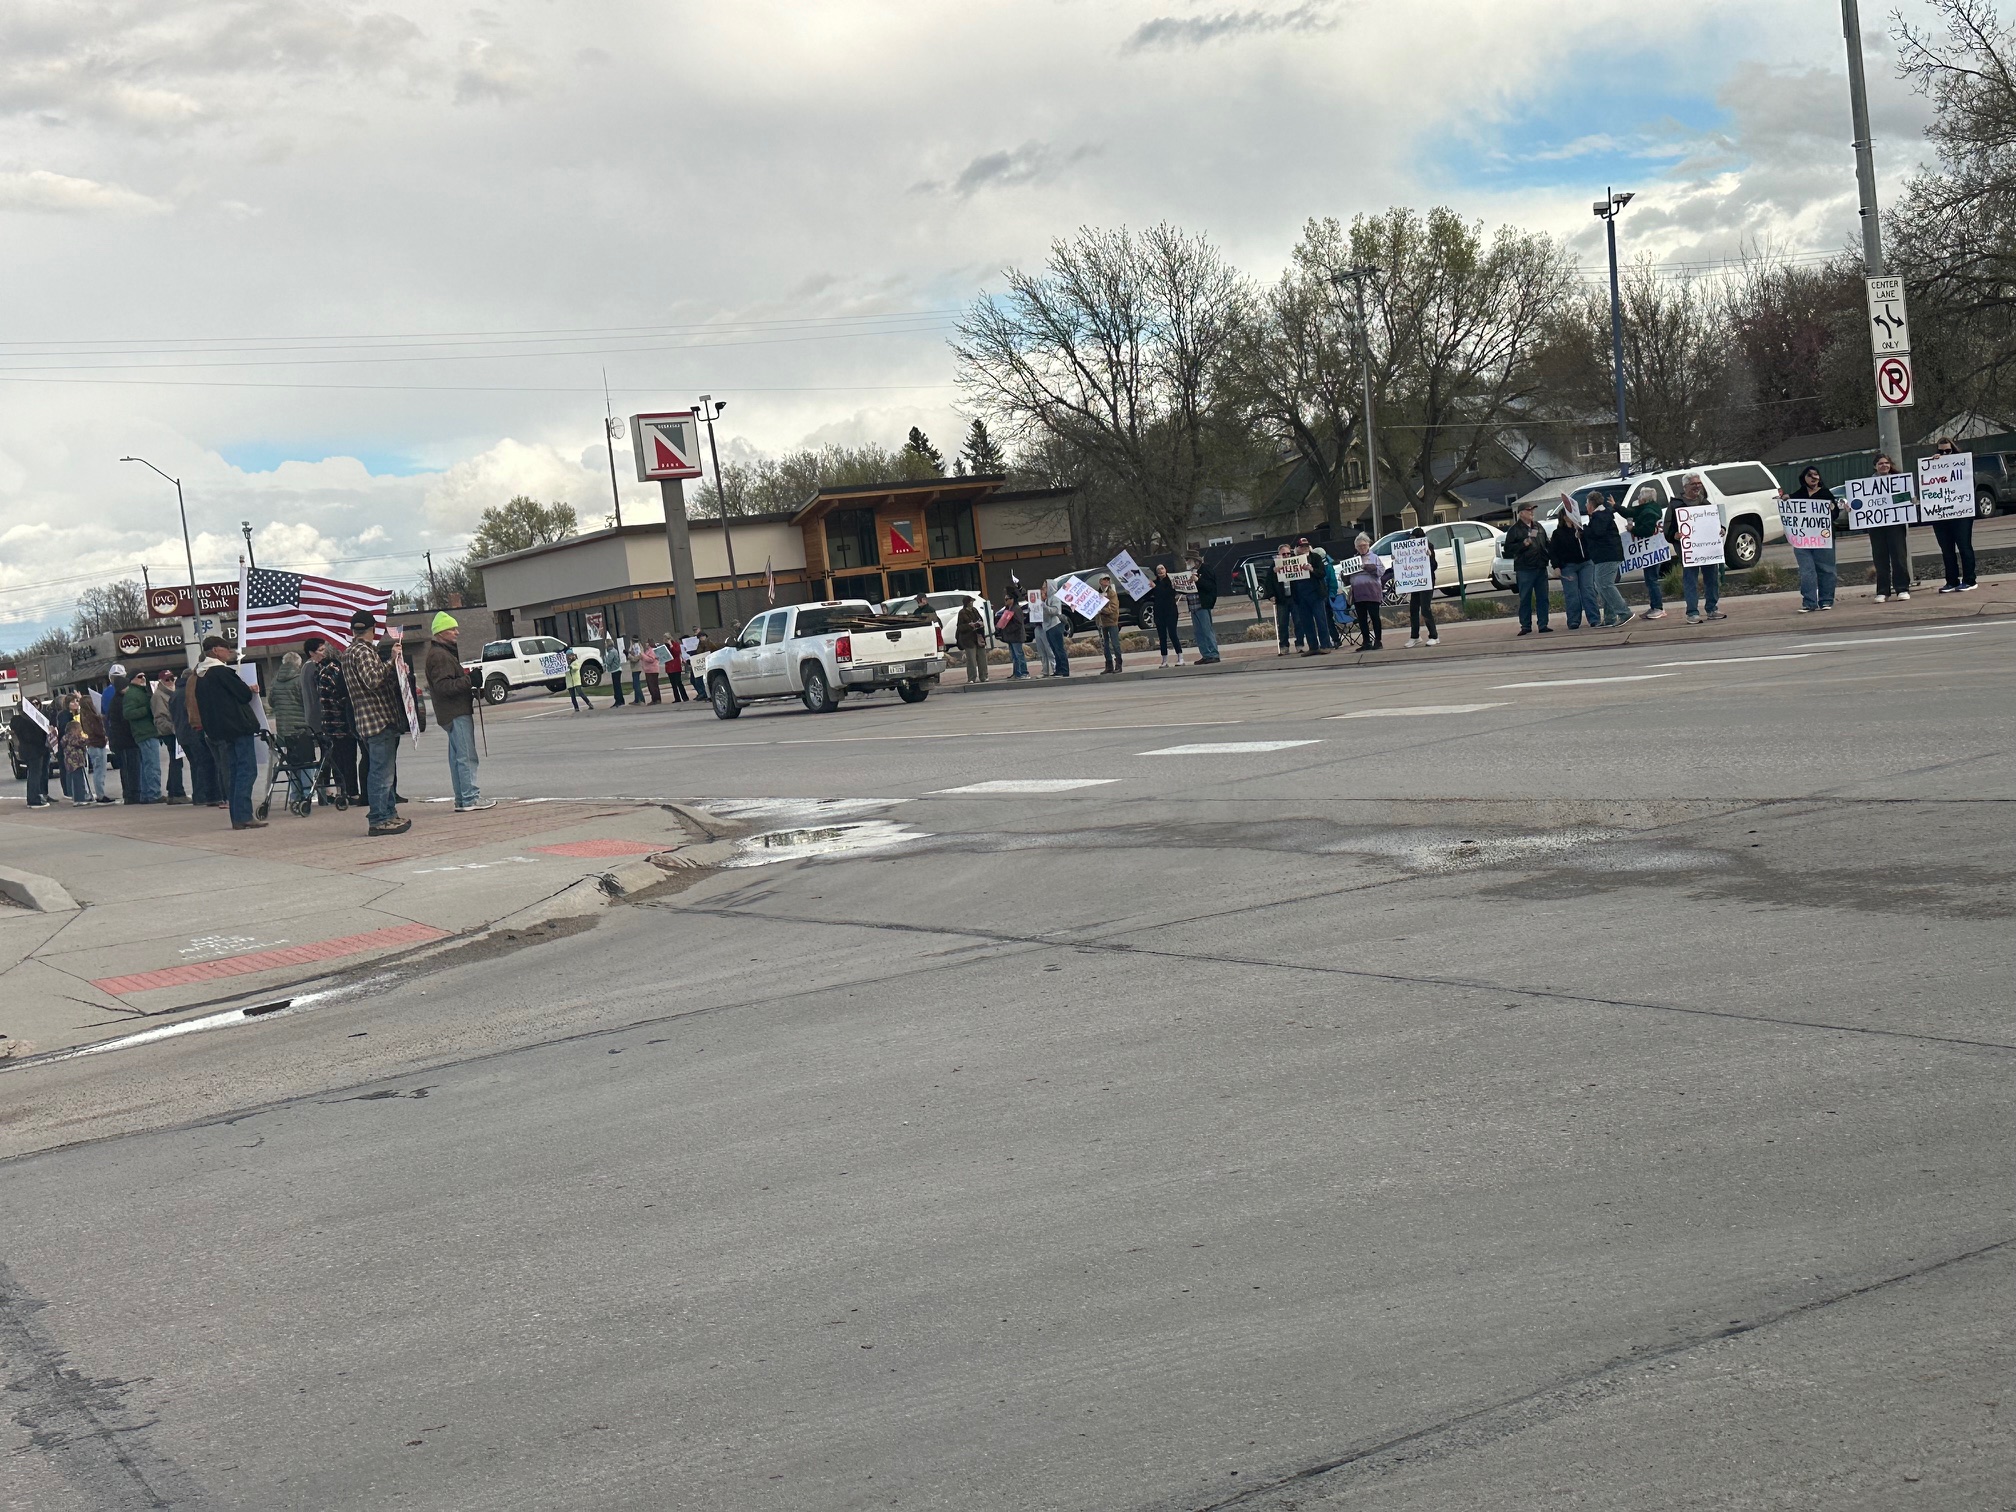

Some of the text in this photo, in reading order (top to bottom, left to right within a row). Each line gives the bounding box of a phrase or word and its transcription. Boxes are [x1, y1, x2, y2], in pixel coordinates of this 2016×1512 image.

[1871, 280, 1899, 289] CENTER
[1876, 290, 1896, 298] LANE
[1882, 341, 1899, 350] ONLY
[1921, 469, 1963, 486] Love All
[1851, 474, 1912, 499] PLANET
[1921, 487, 1943, 500] Feed
[1777, 500, 1830, 516] HATE HAS
[1867, 496, 1888, 508] OVER
[1855, 504, 1914, 527] PROFIT
[1801, 516, 1831, 529] MOVED
[1790, 527, 1806, 538] US
[1619, 545, 1670, 574] HEADSTART
[178, 584, 240, 600] Pltte Valle
[155, 594, 175, 605] PVC
[200, 597, 229, 610] Bank
[144, 634, 183, 648] Platte
